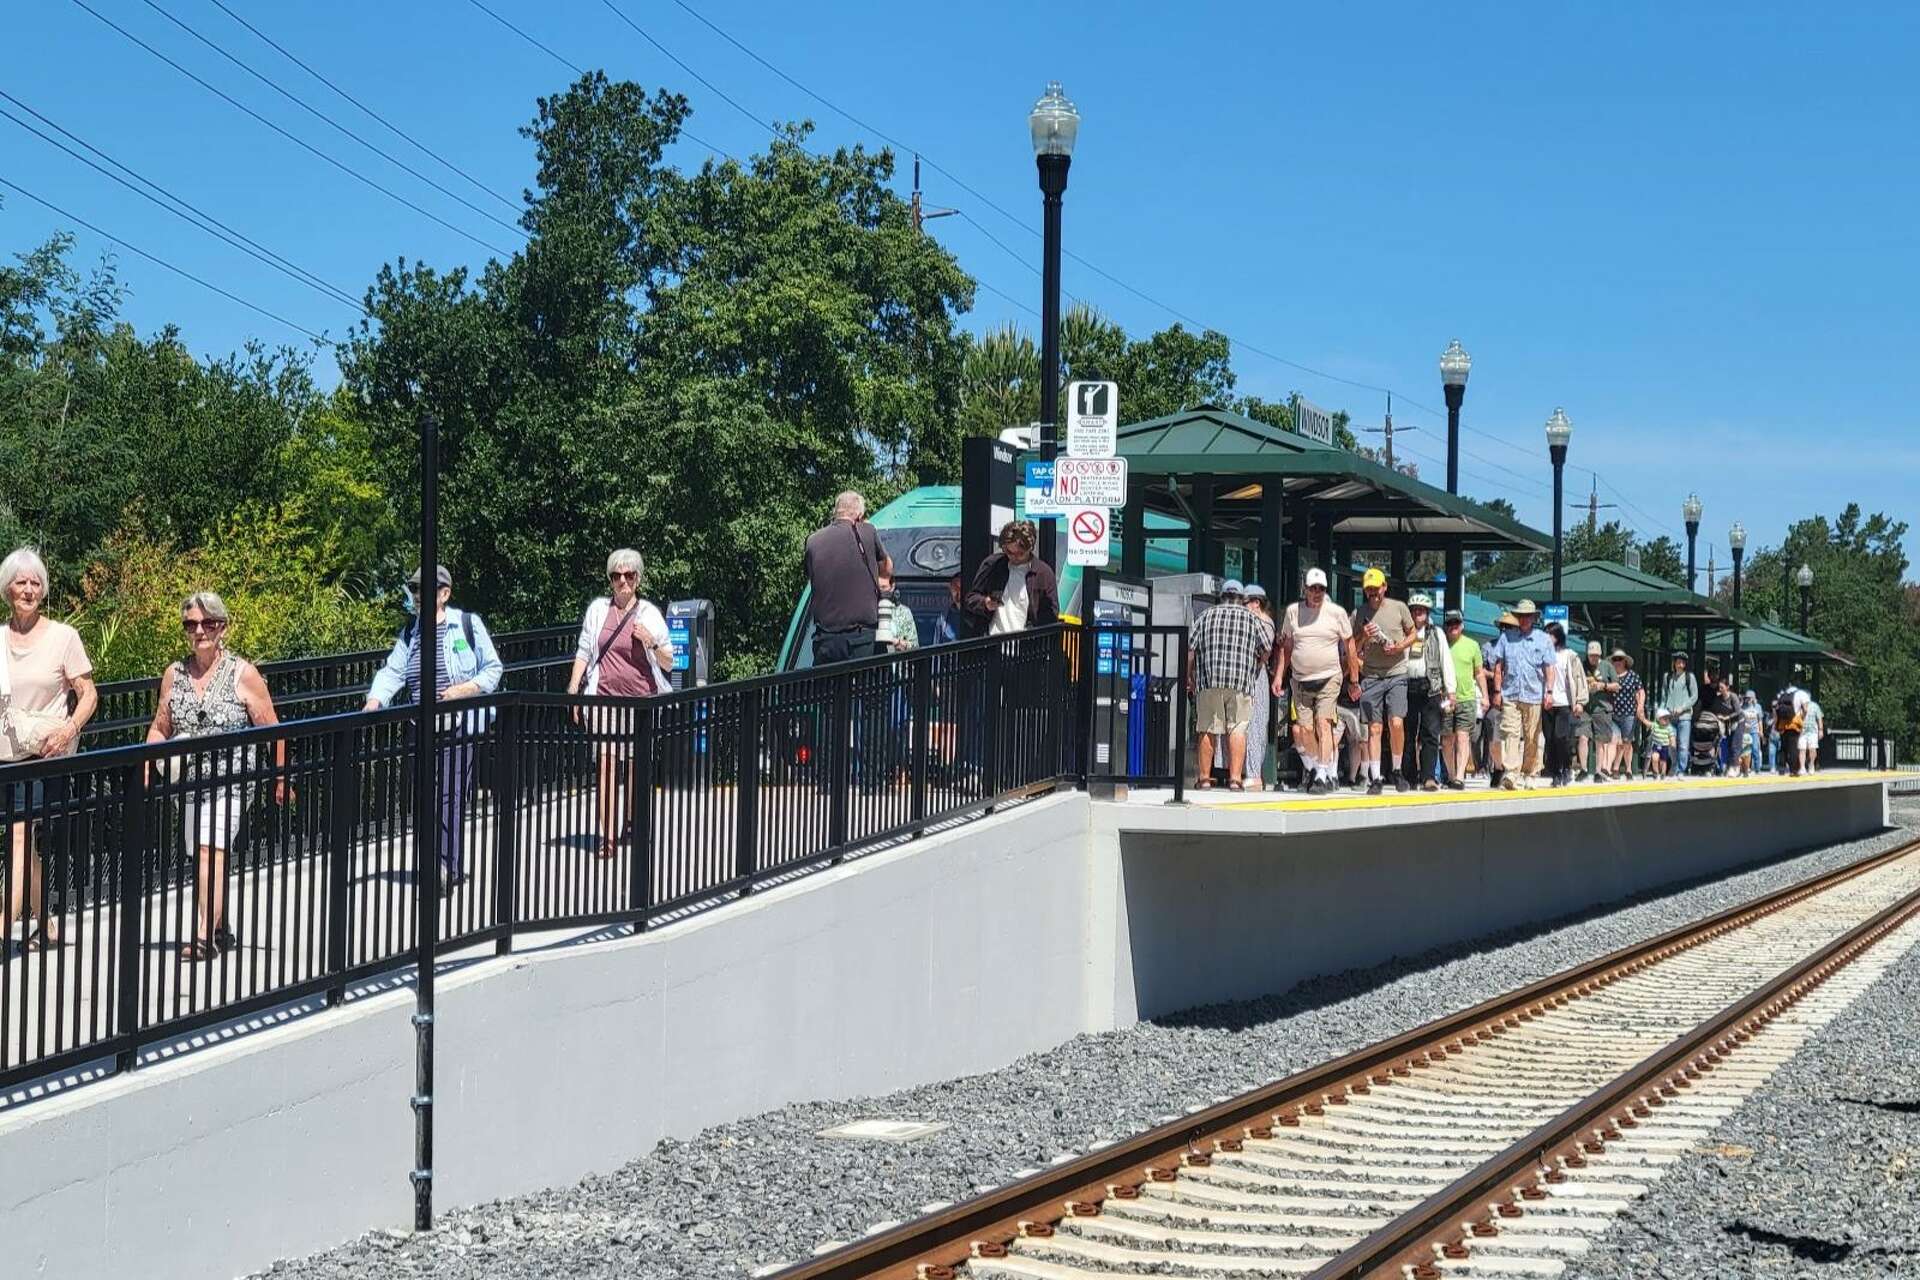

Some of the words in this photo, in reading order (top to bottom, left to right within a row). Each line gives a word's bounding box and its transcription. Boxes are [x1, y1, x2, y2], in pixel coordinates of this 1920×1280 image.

[1301, 406, 1330, 441] WINDSOR
[993, 445, 1013, 464] Windsor
[1032, 467, 1047, 475] TAP
[1060, 476, 1079, 496] NO
[1079, 548, 1108, 557] Smoking
